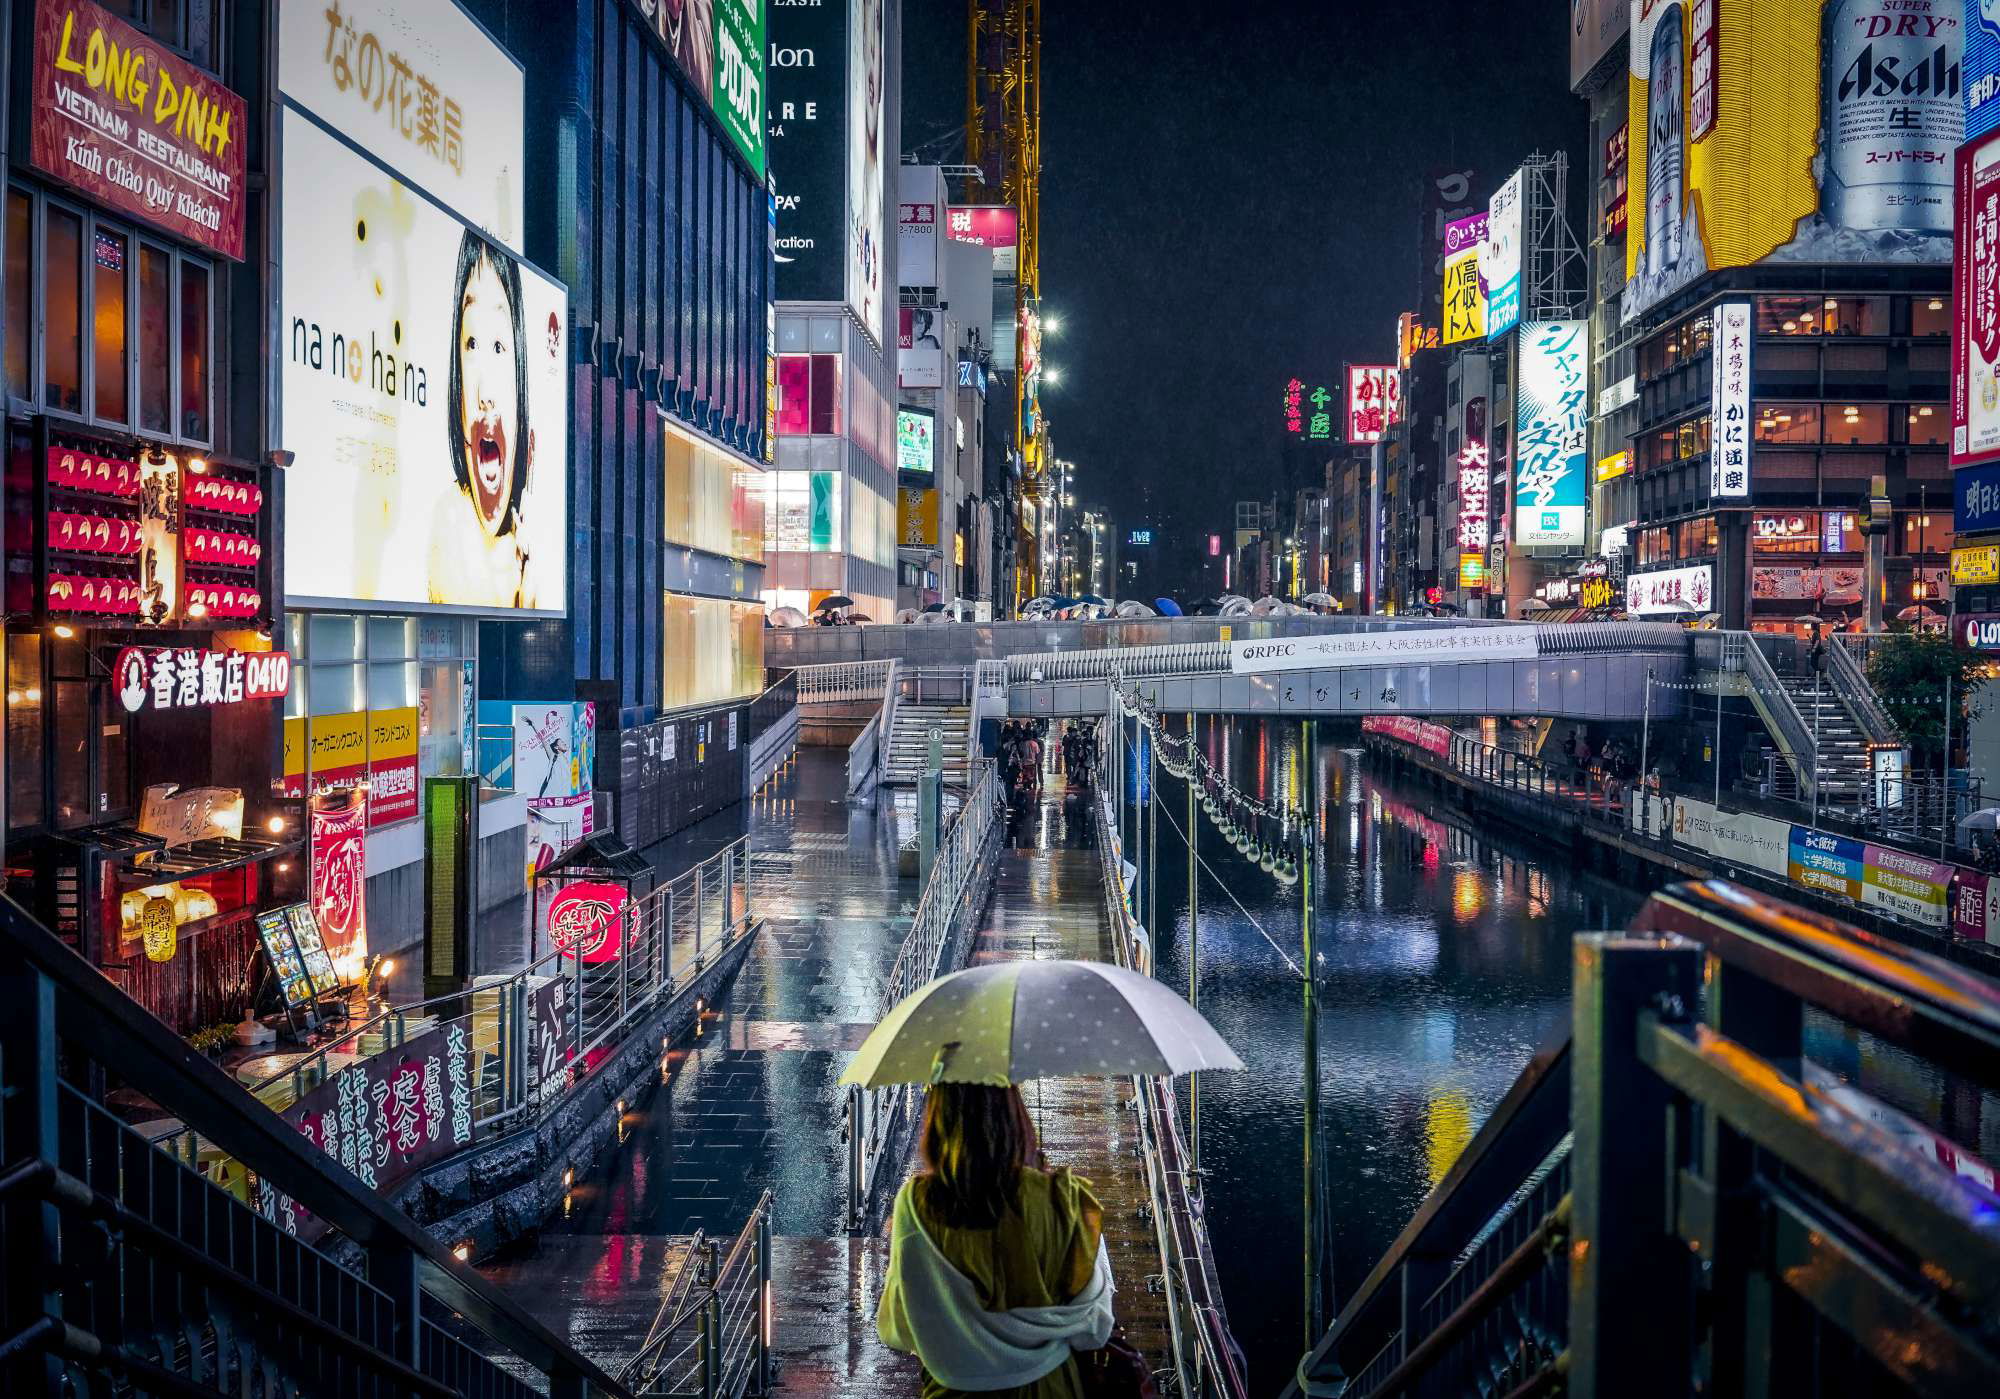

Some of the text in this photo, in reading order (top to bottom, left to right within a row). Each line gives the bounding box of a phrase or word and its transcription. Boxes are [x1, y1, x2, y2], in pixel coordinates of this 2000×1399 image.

[1882, 0, 1932, 12] SUPER
[54, 10, 231, 158] LONG DINH
[323, 2, 464, 177] なの花薬局
[1889, 106, 1922, 130] 生
[55, 82, 231, 194] VIETNAM RESTAURANT
[1866, 150, 1946, 165] スーパードライ
[65, 136, 221, 231] Kính Chào Quý Khách!
[1886, 194, 1920, 206] 生ビール
[952, 212, 972, 233] 税
[1975, 211, 1987, 262] 牛乳
[1447, 263, 1462, 340] バイト
[1463, 258, 1478, 336] 高収入
[1728, 336, 1743, 396] 本場の味
[1725, 403, 1744, 489] かに道楽
[1457, 441, 1488, 546] 大阪王将
[1528, 532, 1574, 540] 文化シャッター
[151, 649, 245, 708] 香港飯店
[247, 655, 289, 695] 0410
[1284, 687, 1398, 703] えびす橋
[311, 730, 364, 754] オーガニックコスメ
[374, 725, 412, 745] ブランドコスメ
[392, 1070, 421, 1152] 定食
[421, 1055, 446, 1142] 唐揚げ
[447, 1024, 472, 1144] 大衆食堂
[337, 1070, 358, 1176] 大衆酒
[352, 1067, 378, 1190] 年中無休
